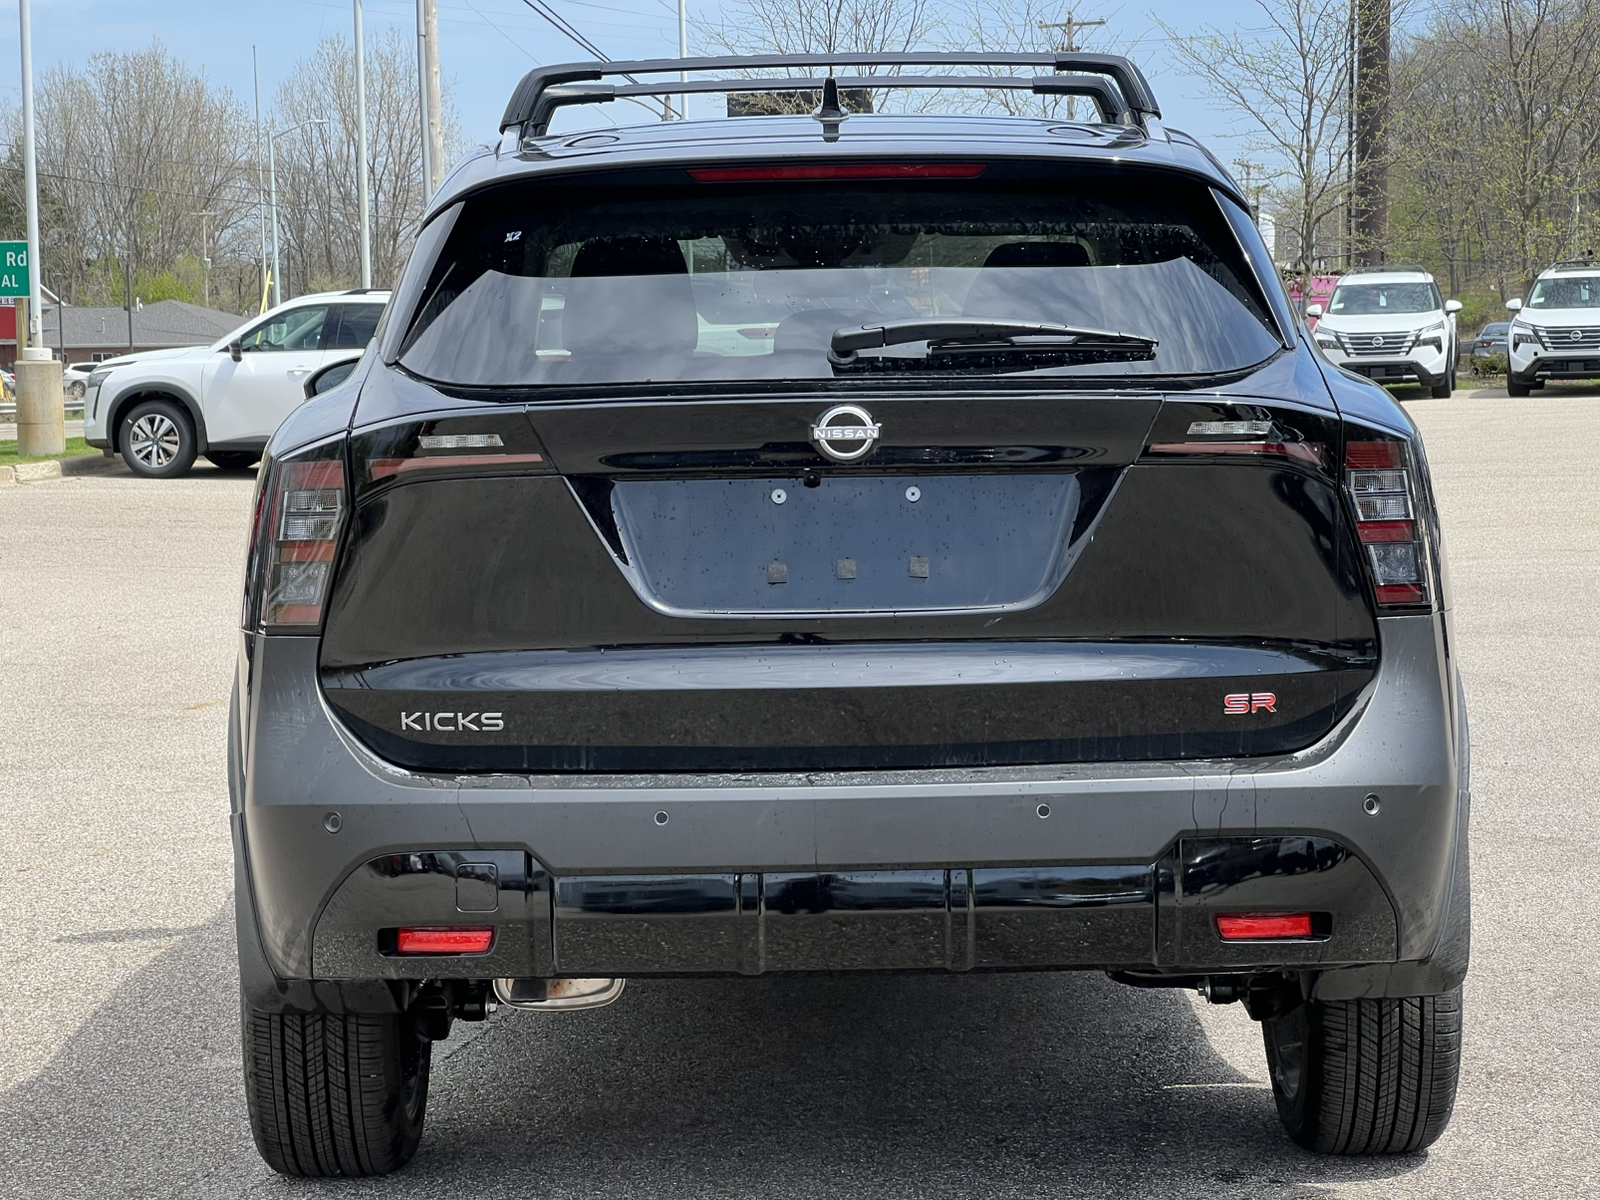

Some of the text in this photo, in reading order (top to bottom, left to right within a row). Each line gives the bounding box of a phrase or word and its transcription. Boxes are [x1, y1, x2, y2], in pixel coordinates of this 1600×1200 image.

[6, 250, 27, 267] Rd
[1, 274, 19, 288] AL
[815, 429, 877, 438] NISSAN
[1223, 692, 1277, 715] SR
[400, 711, 505, 731] KICKS
